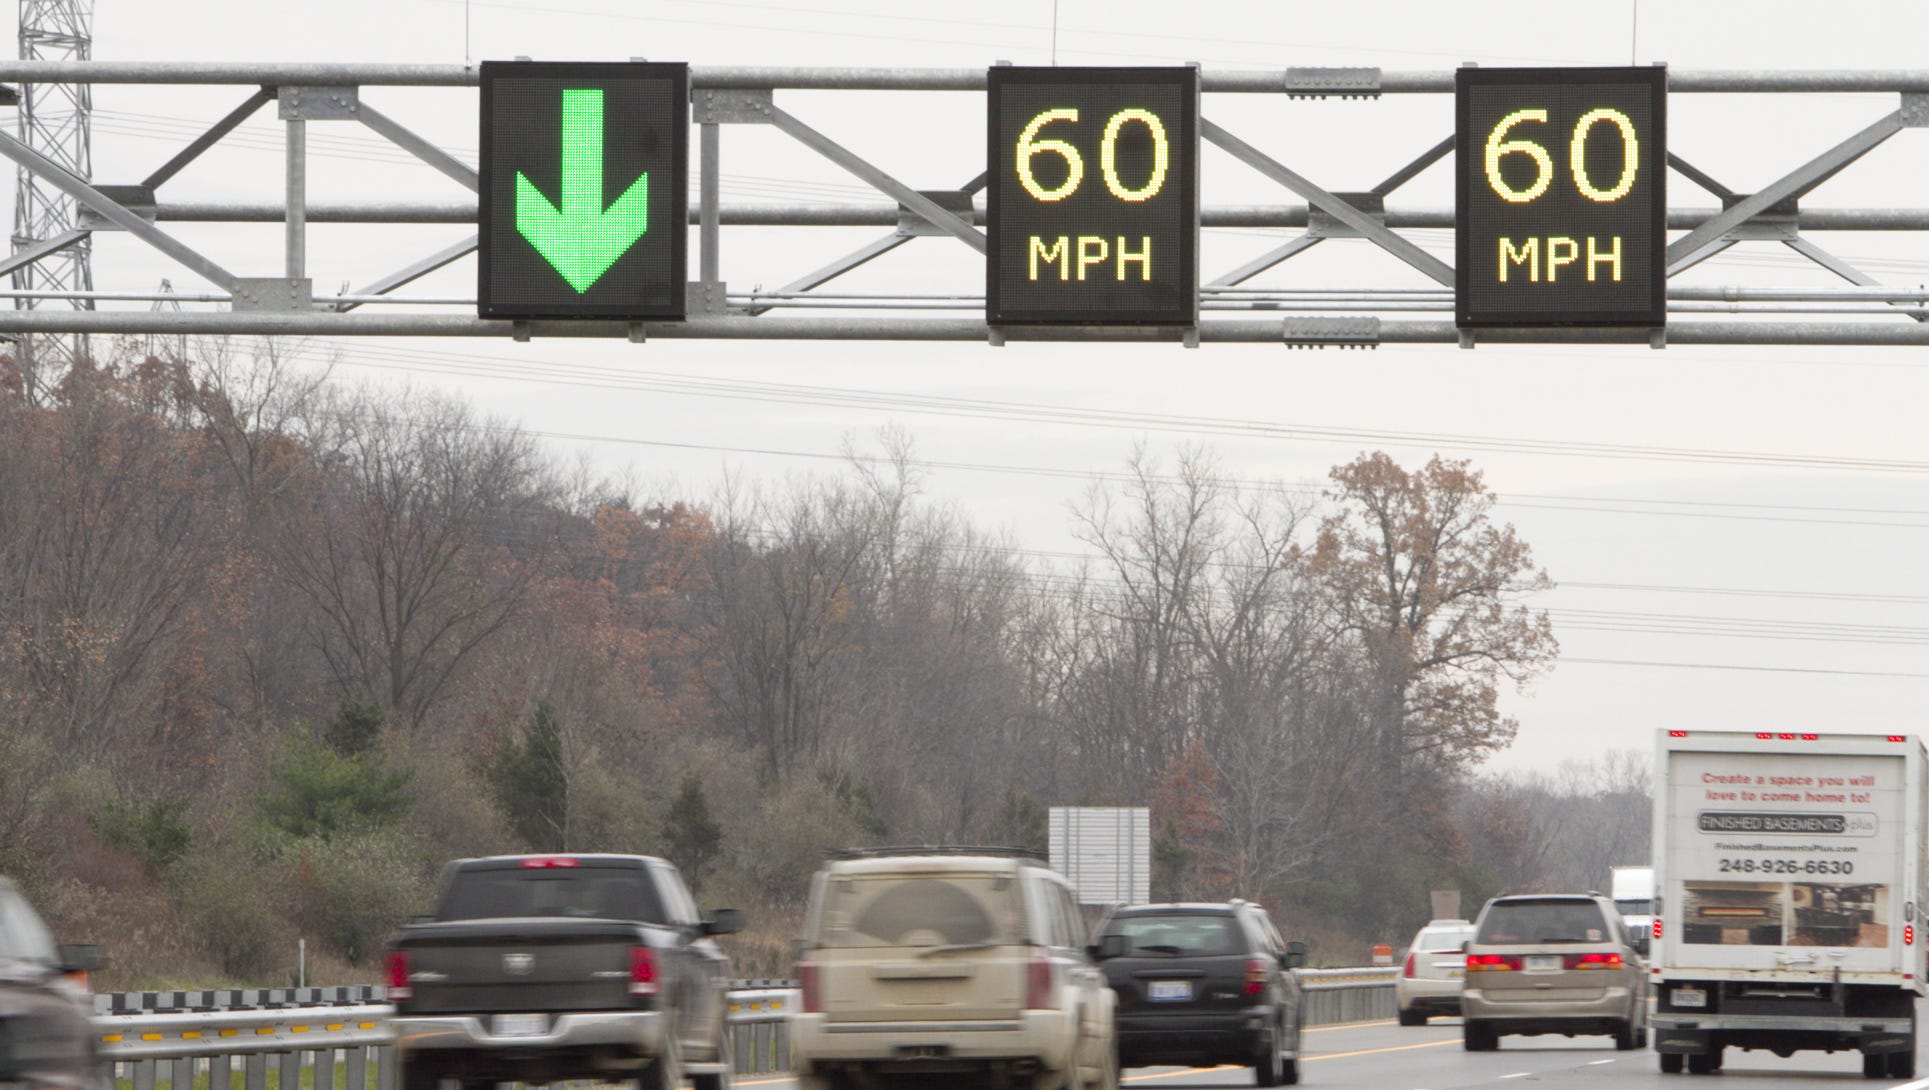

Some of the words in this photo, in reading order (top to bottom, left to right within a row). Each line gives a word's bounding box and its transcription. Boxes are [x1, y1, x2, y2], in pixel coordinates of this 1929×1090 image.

[1016, 108, 1168, 202] 60
[1484, 108, 1638, 203] 60
[1029, 236, 1151, 281] MPH
[1498, 237, 1621, 282] MPH
[1702, 772, 1751, 784] Create
[1755, 775, 1765, 785] a
[1769, 776, 1813, 788] space
[1817, 777, 1844, 788] you
[1848, 775, 1875, 786] will
[1705, 789, 1736, 801] love
[1741, 789, 1757, 801] to
[1760, 793, 1801, 802] come
[1805, 791, 1846, 803] home
[1850, 792, 1870, 803] to!
[1701, 815, 1762, 829] FINISHED
[1763, 817, 1842, 831] BASEMENTS
[1719, 859, 1854, 875] 248-926-6630
